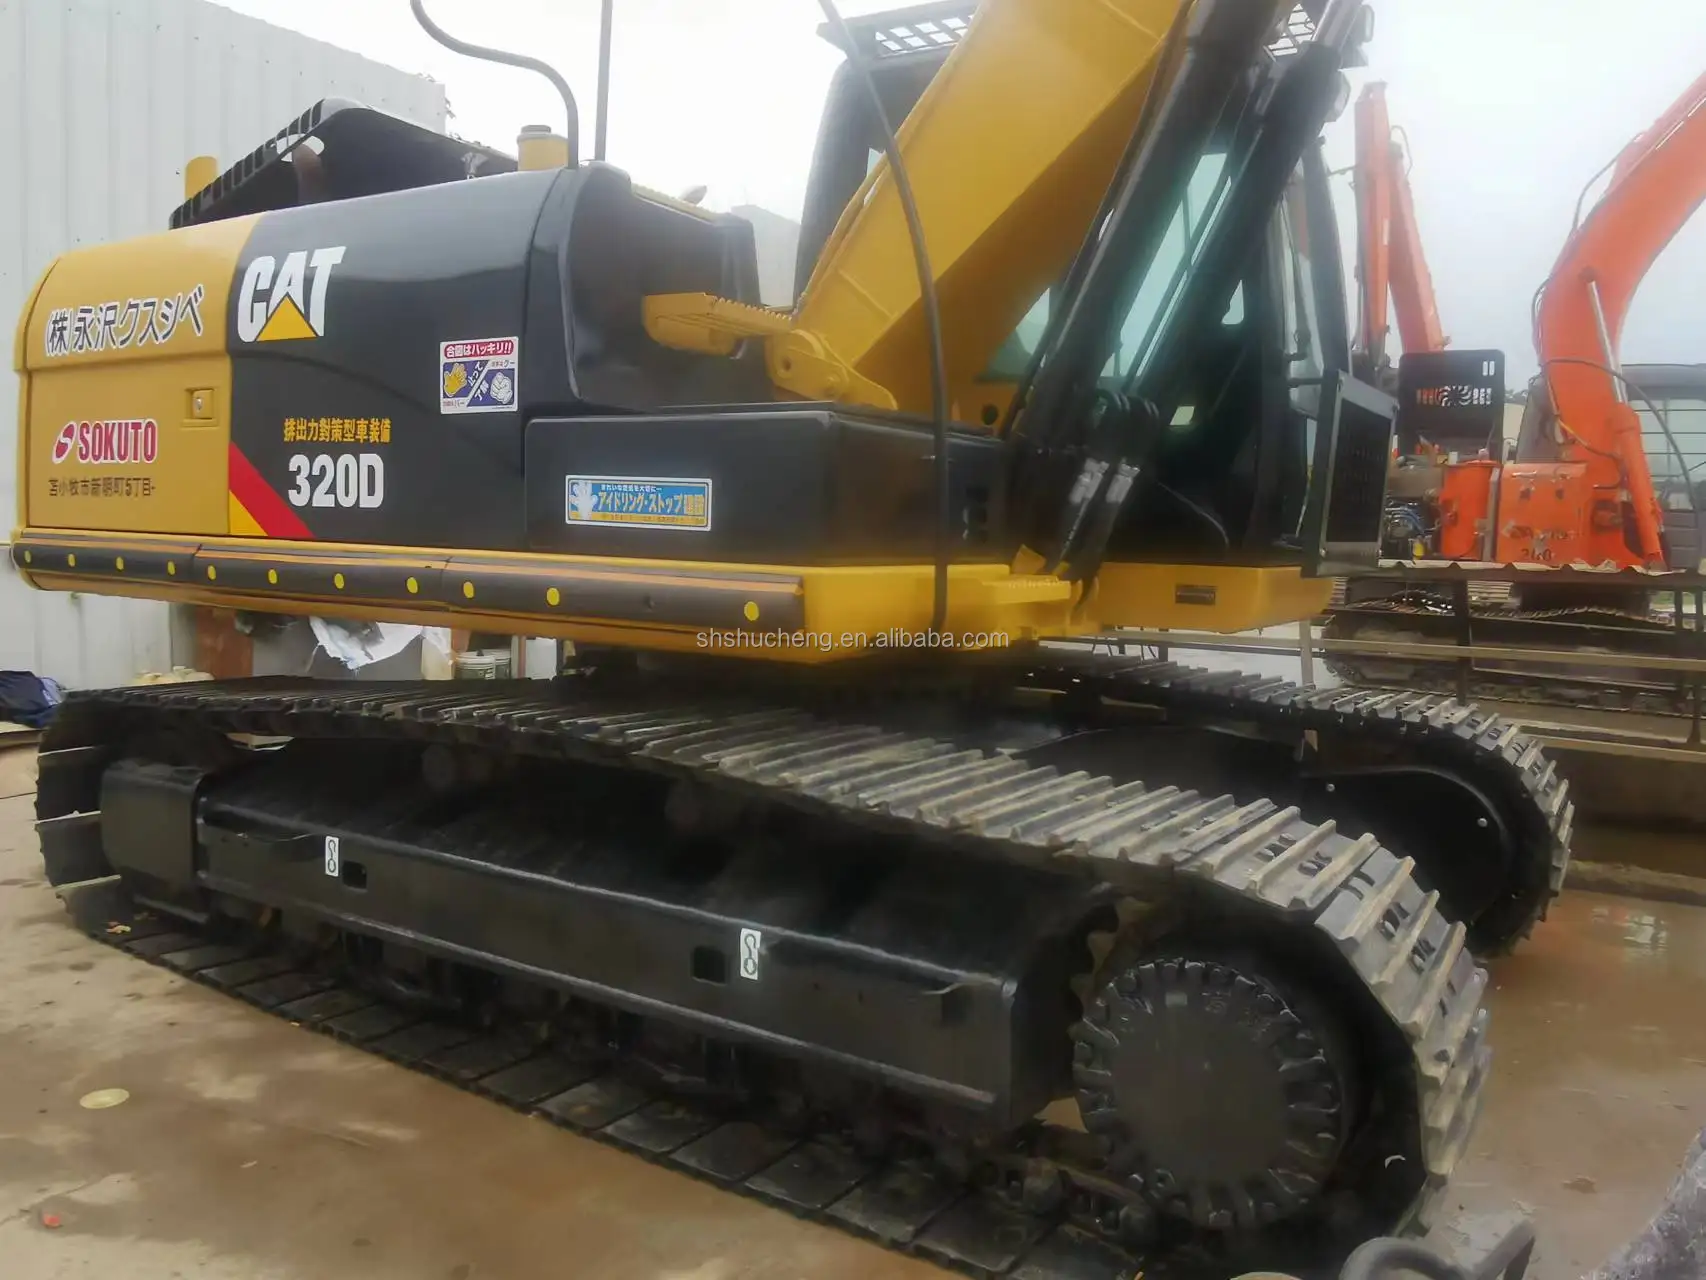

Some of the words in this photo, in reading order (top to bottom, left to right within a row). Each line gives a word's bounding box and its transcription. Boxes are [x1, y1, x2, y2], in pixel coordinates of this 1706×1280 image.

[237, 246, 347, 343] CAT
[78, 419, 158, 464] SOKUTO
[287, 453, 384, 509] 320D
